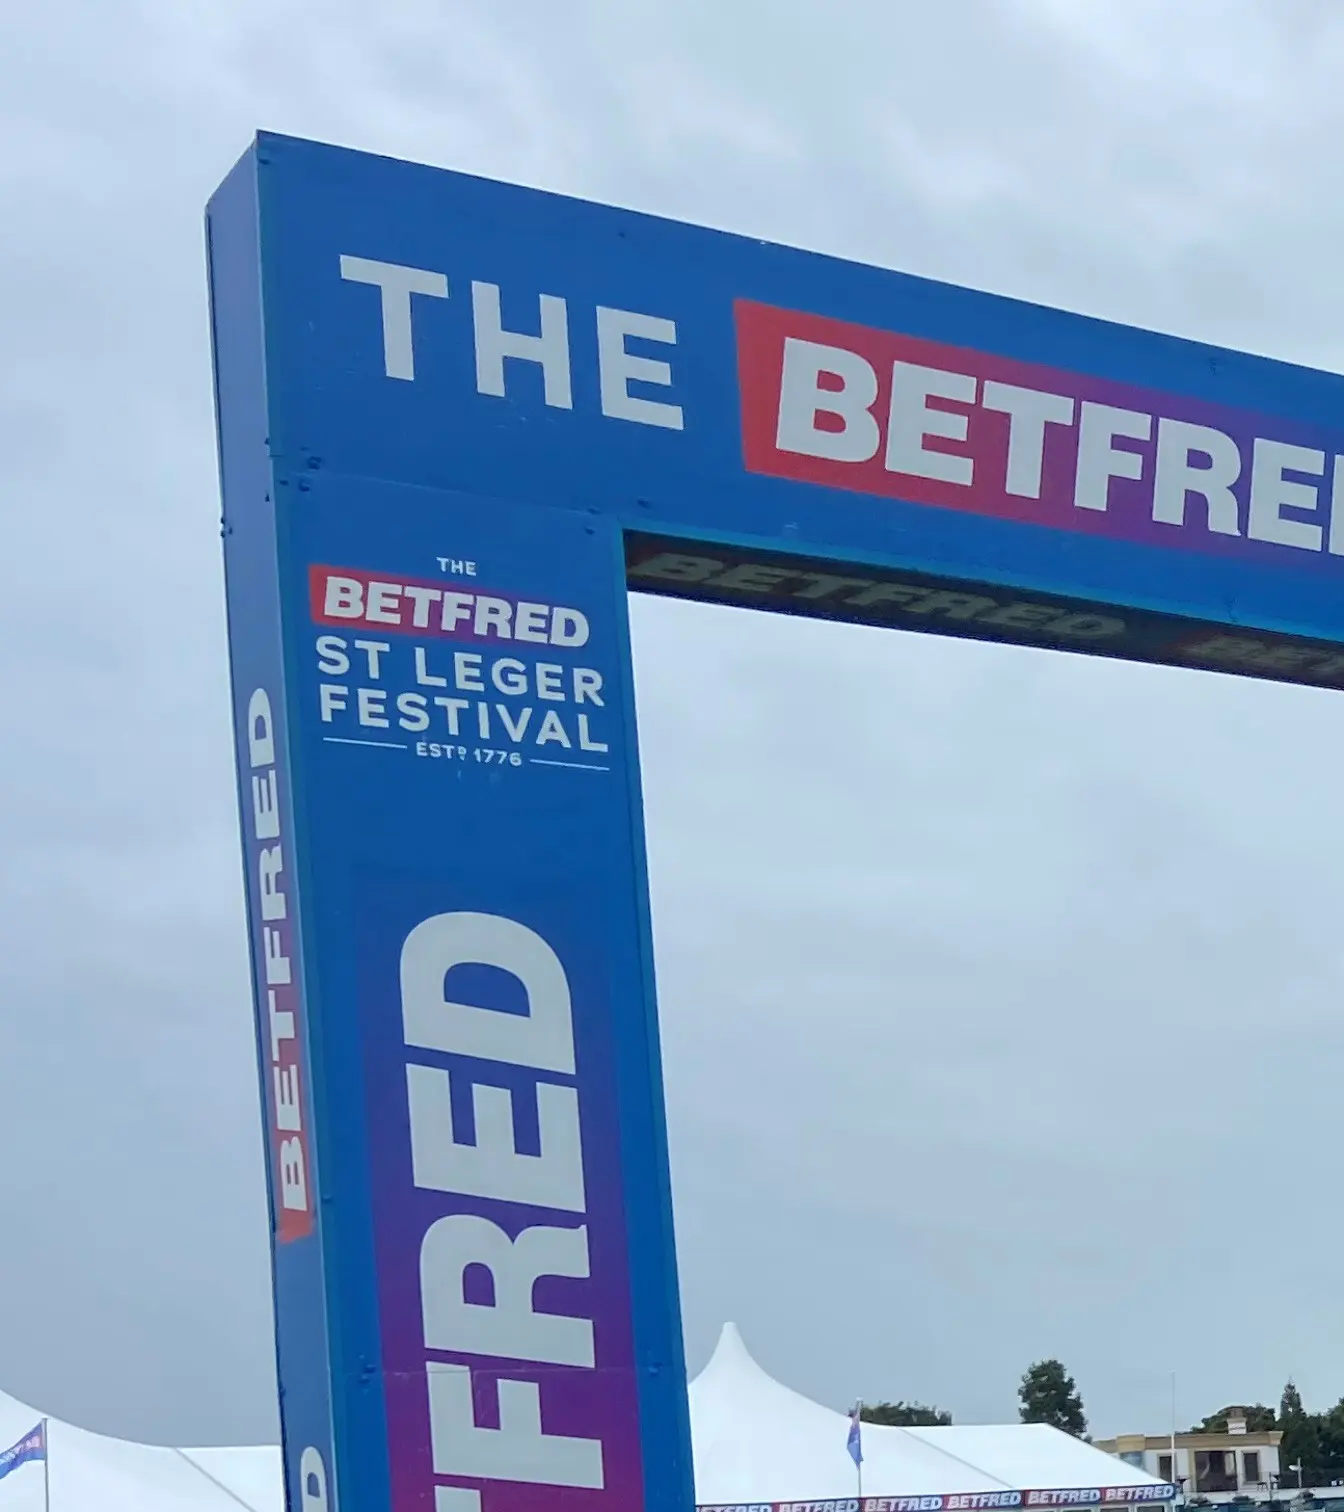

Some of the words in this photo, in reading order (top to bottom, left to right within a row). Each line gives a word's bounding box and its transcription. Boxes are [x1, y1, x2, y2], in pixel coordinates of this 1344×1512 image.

[339, 254, 684, 431] THE
[436, 556, 477, 577] THE
[629, 553, 1124, 641] BETFRED
[324, 576, 590, 647] BETFRED
[316, 635, 390, 680] ST
[414, 647, 605, 707] LEGER
[319, 683, 609, 753] FESTIVAL
[474, 748, 522, 767] 1776
[248, 687, 307, 1213] BETFRED
[865, 1496, 942, 1512] BETFRED
[947, 1491, 1021, 1509] BETFRED
[1028, 1489, 1100, 1506] BETFRED
[1105, 1485, 1174, 1501] BETFRED
